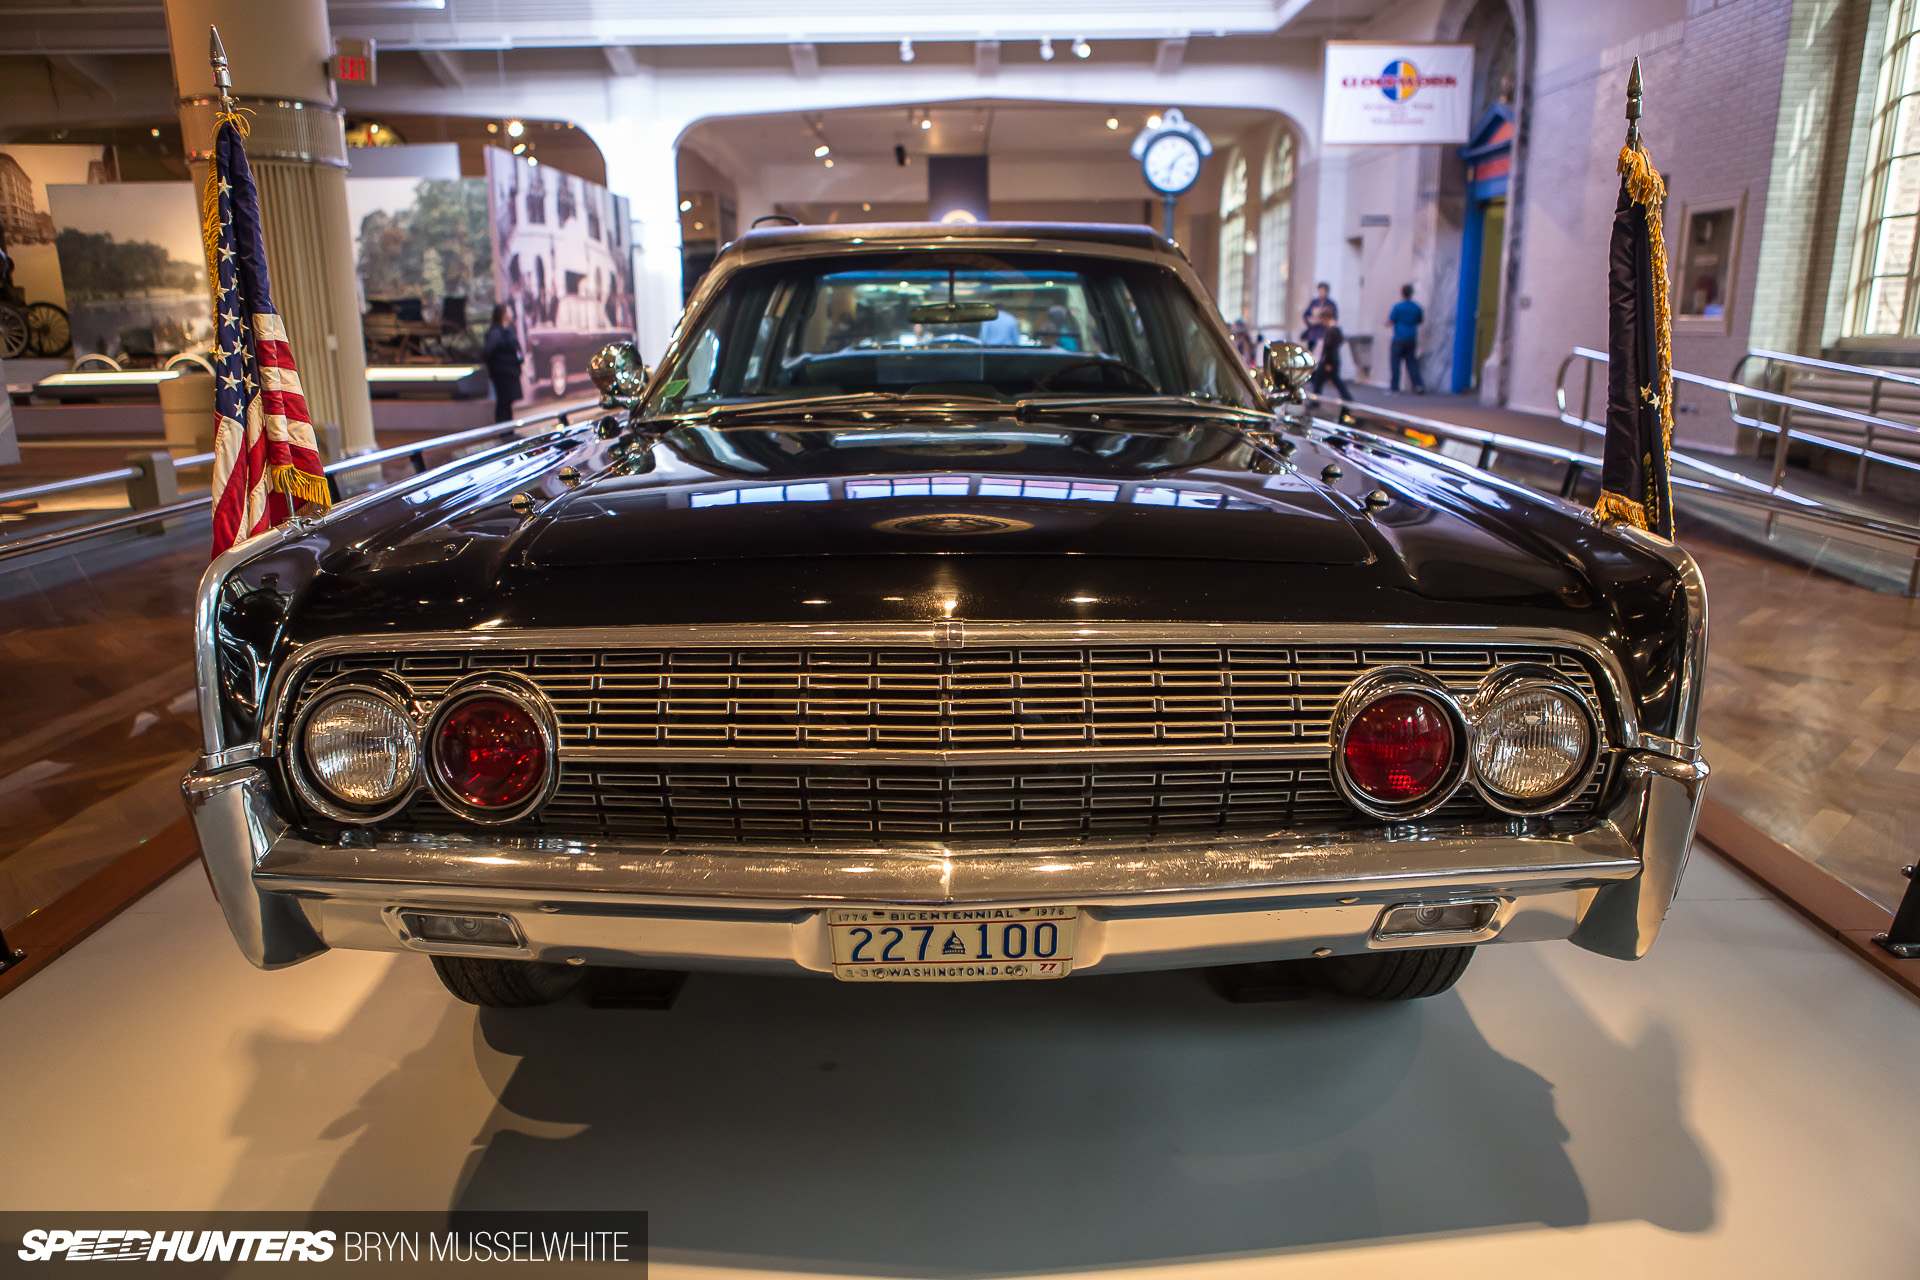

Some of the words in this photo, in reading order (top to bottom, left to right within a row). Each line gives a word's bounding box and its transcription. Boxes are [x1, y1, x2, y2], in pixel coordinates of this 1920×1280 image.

[339, 56, 366, 80] EXIT
[839, 914, 868, 922] 1776
[890, 909, 1014, 921] BICENTENNIAL
[1036, 908, 1065, 917] 1976
[849, 925, 935, 962] 227
[976, 922, 1058, 959] 100
[1039, 963, 1058, 972] 77
